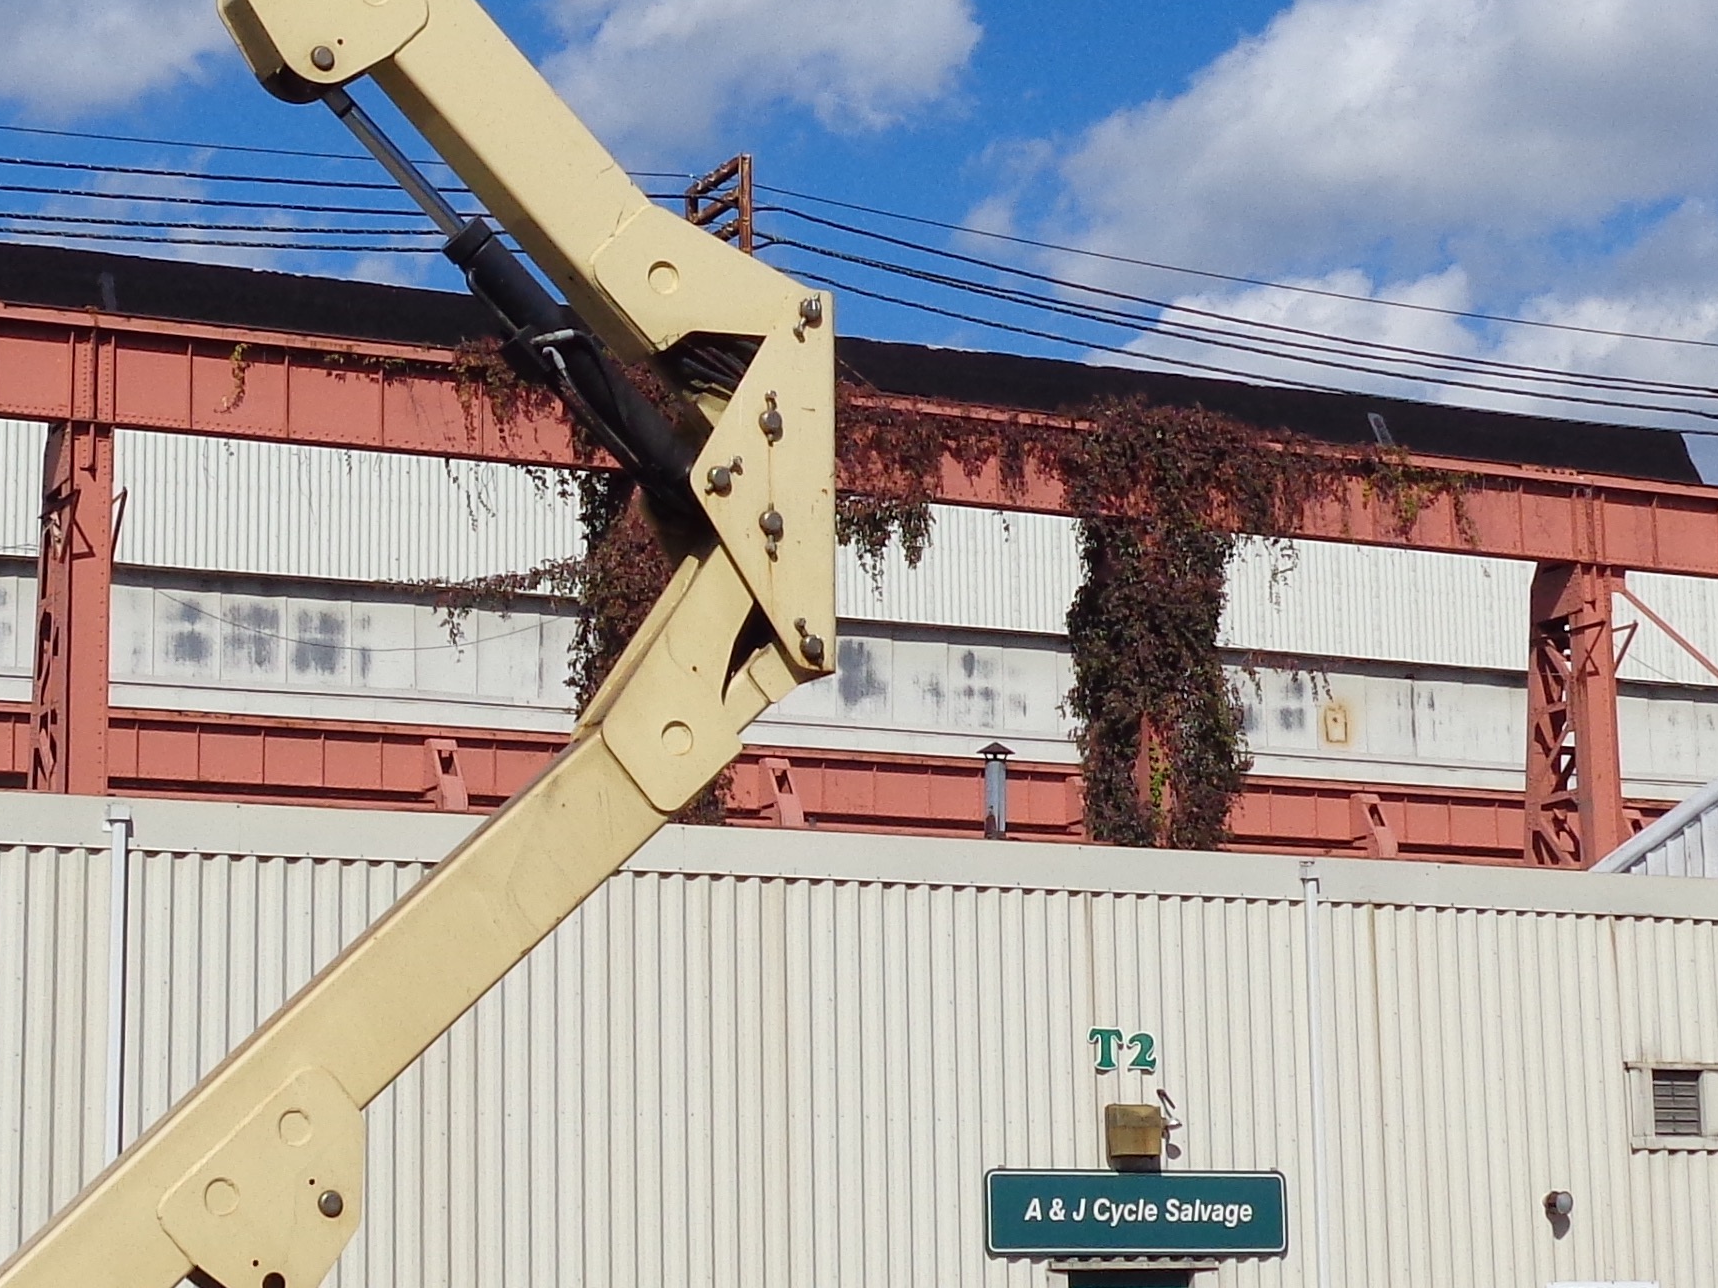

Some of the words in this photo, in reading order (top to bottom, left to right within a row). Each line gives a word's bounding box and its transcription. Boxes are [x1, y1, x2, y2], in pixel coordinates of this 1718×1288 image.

[1087, 1026, 1158, 1072] T2
[1024, 1198, 1043, 1222] A
[1048, 1198, 1066, 1222] &
[1072, 1198, 1087, 1222] J
[1093, 1198, 1159, 1227] Cycle
[1164, 1198, 1254, 1228] Salvage
